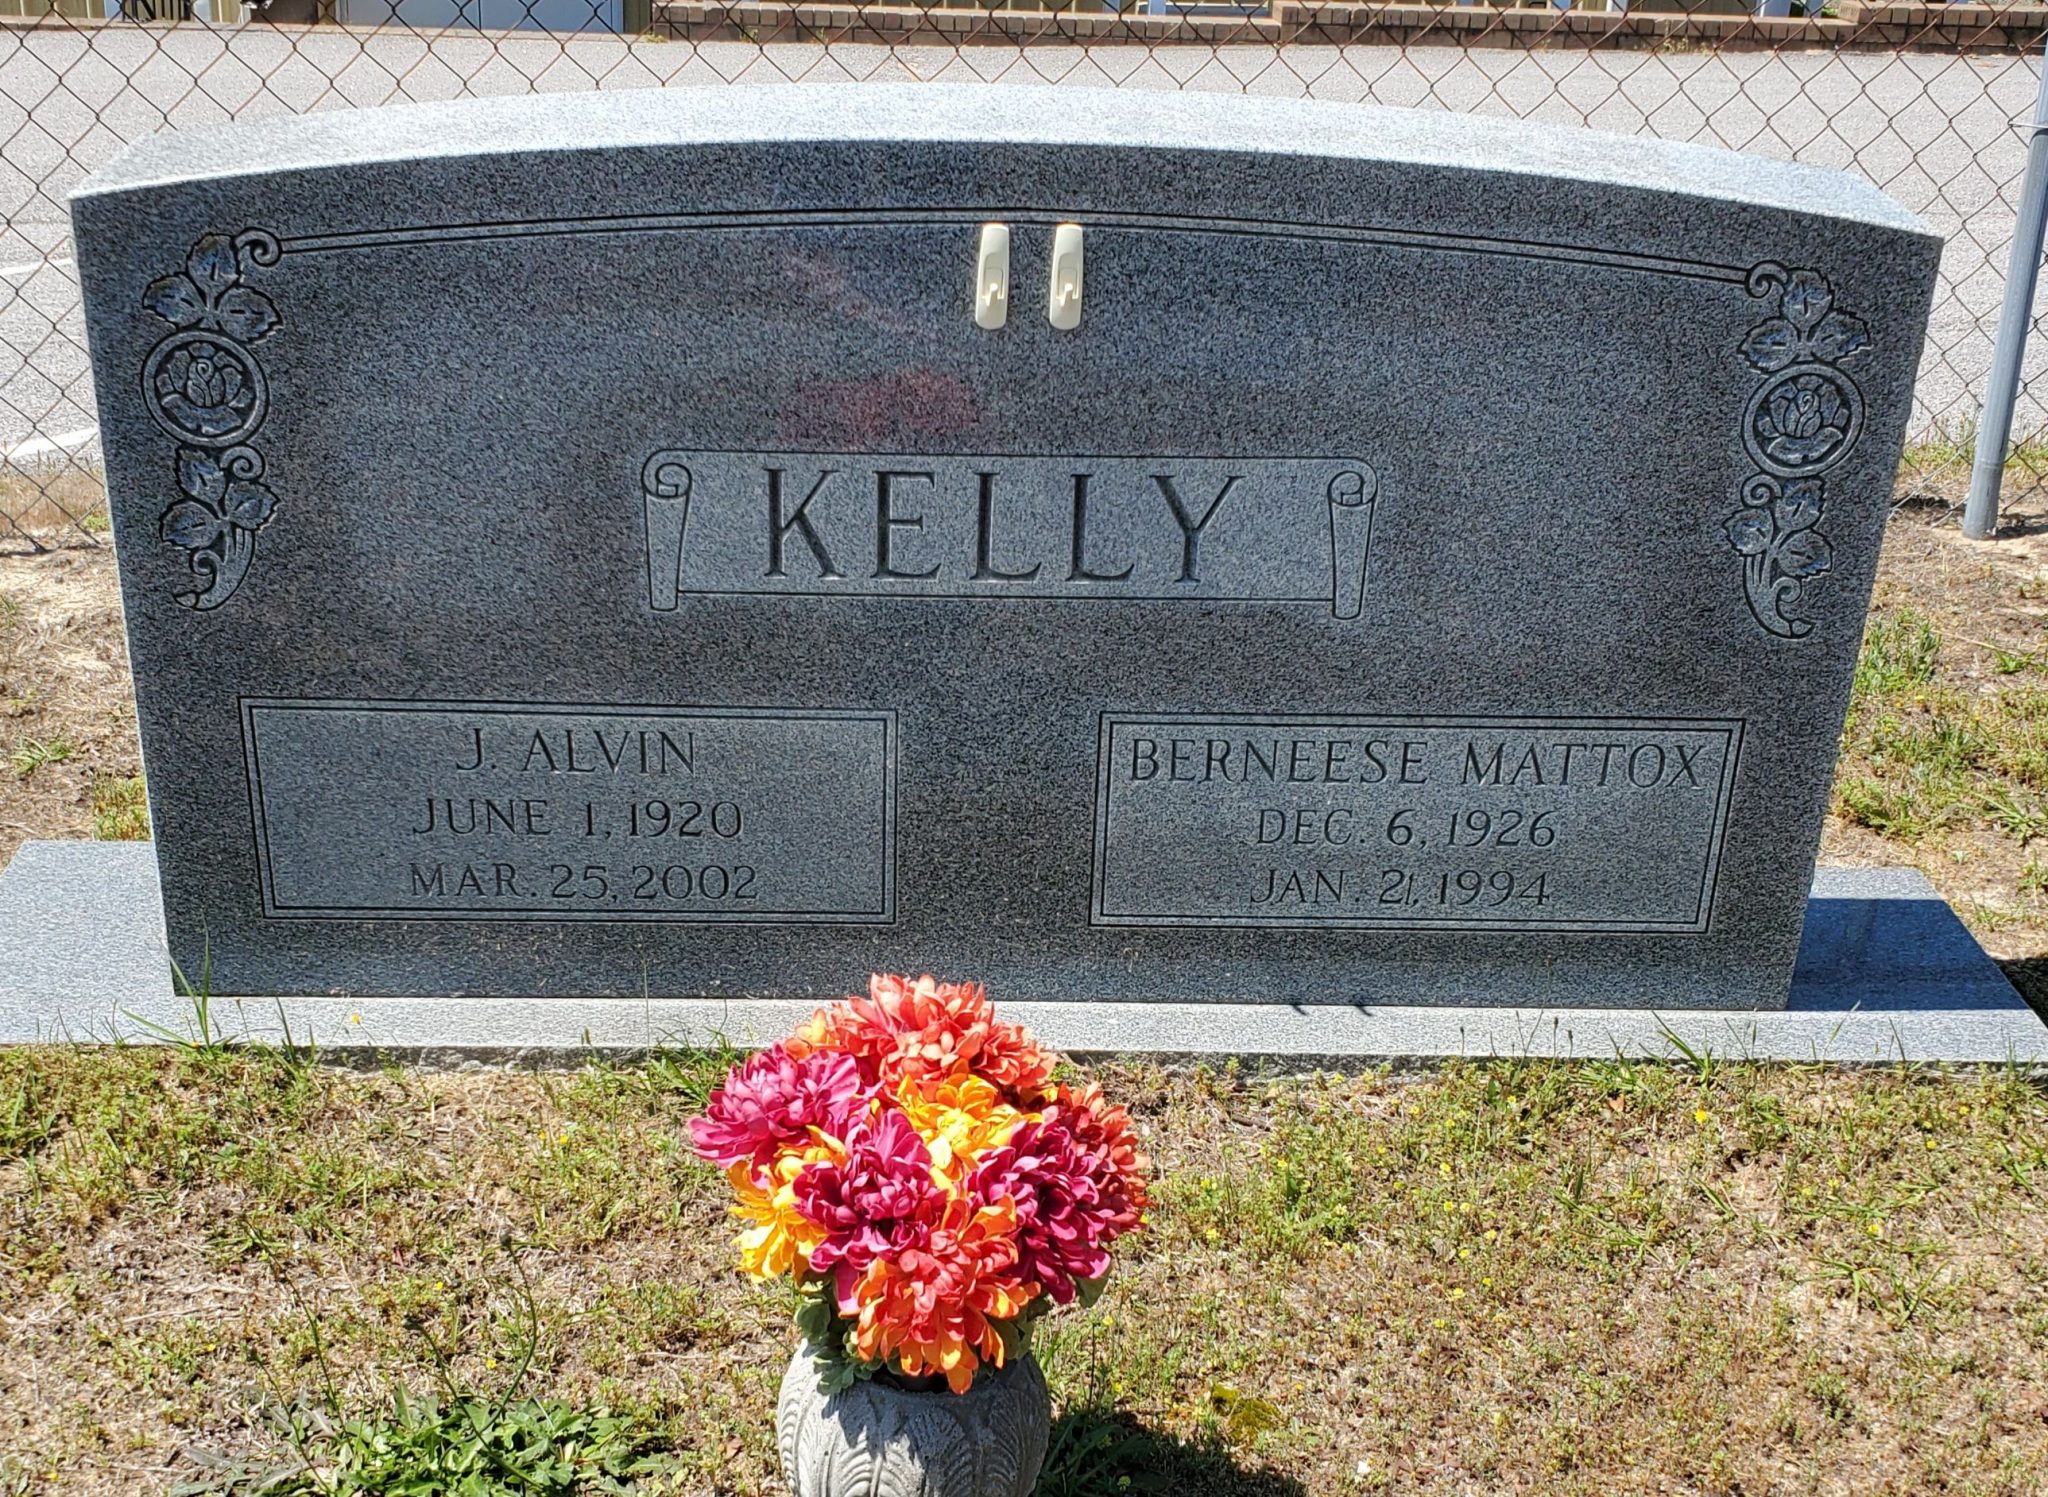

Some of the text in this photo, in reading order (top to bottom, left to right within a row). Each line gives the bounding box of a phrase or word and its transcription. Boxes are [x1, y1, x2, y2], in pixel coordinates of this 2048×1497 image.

[762, 467, 1246, 584] KELLY
[456, 729, 697, 775] J. ALVIN
[1130, 738, 1705, 789] BERNEESE MATTOX
[412, 799, 552, 837] JUNE
[1256, 808, 1367, 846] DEC.
[409, 862, 535, 899] MAR.
[1250, 868, 1363, 905] JAN.
